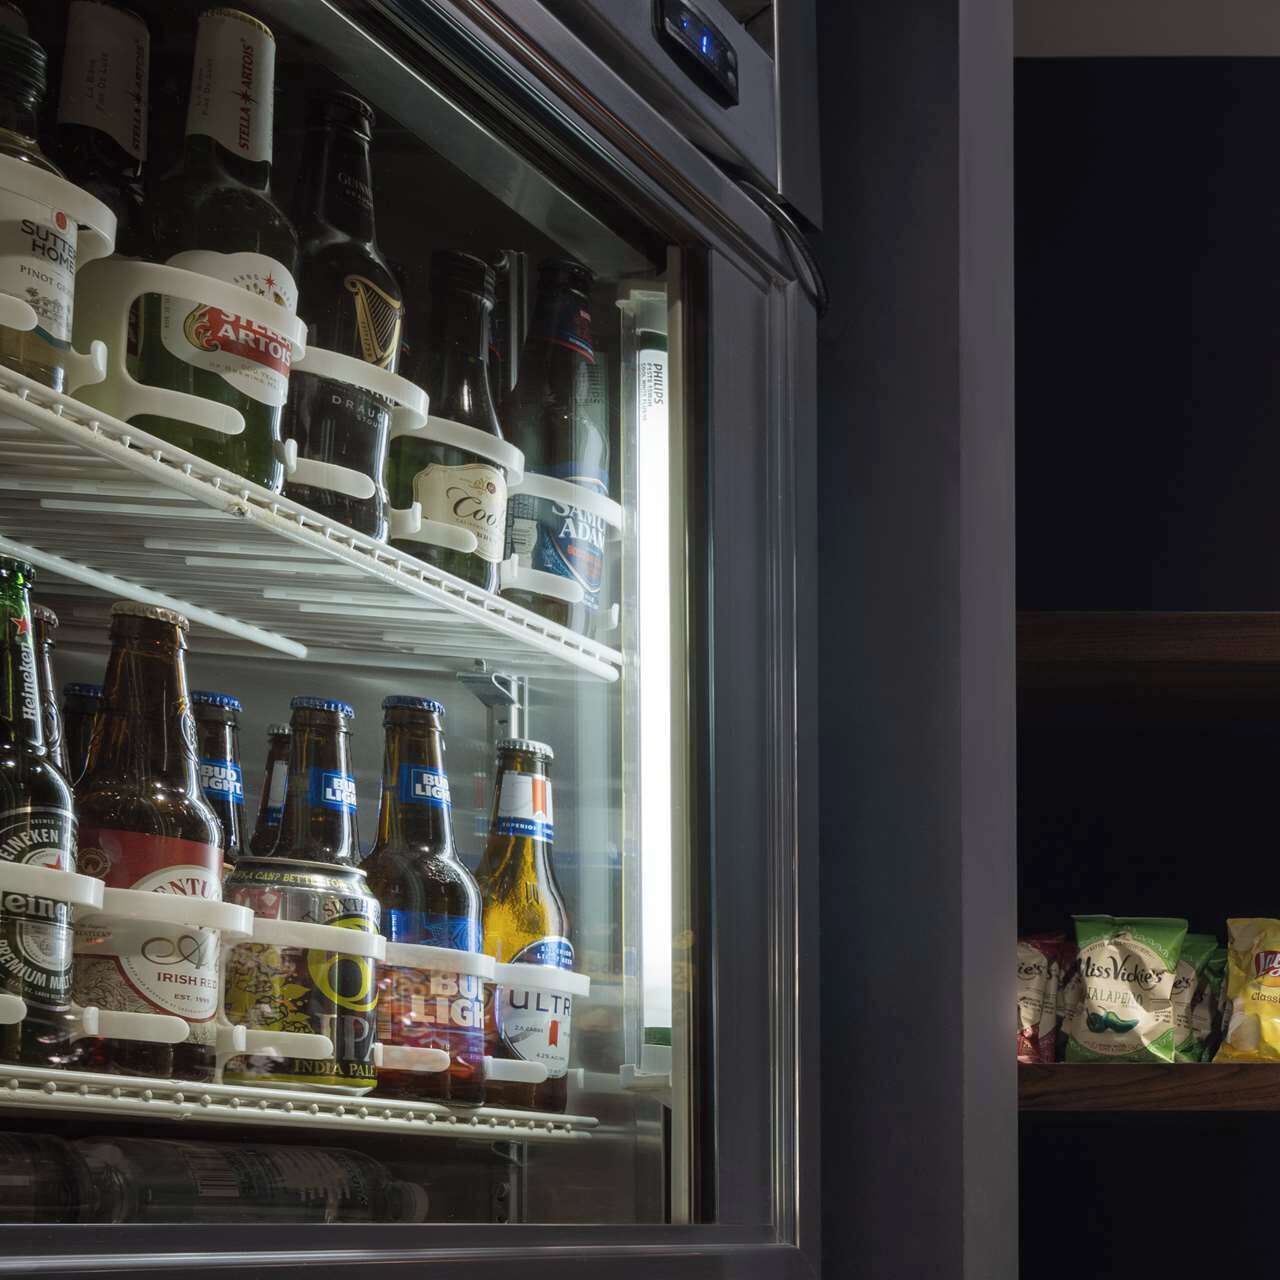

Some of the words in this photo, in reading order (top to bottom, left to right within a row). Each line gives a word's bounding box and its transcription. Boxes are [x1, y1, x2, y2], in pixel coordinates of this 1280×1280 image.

[241, 44, 254, 88] ARTOIS
[239, 107, 252, 150] STELLA
[31, 239, 75, 277] HOME
[20, 264, 54, 286] PINOT
[218, 324, 291, 366] ARTOIS
[653, 362, 664, 406] PHILIPS
[446, 485, 498, 527] Coo
[22, 641, 38, 721] Heineken
[200, 764, 238, 783] BUD
[200, 777, 244, 797] IGHT
[326, 787, 357, 803] LIG
[415, 783, 450, 800] LIG
[0, 829, 59, 861] EINEKEN
[157, 971, 198, 986] IRISH
[1109, 953, 1166, 991] Vickie's
[412, 997, 485, 1029] LIGH
[509, 988, 571, 1018] ULTR
[294, 1060, 345, 1076] INDIA
